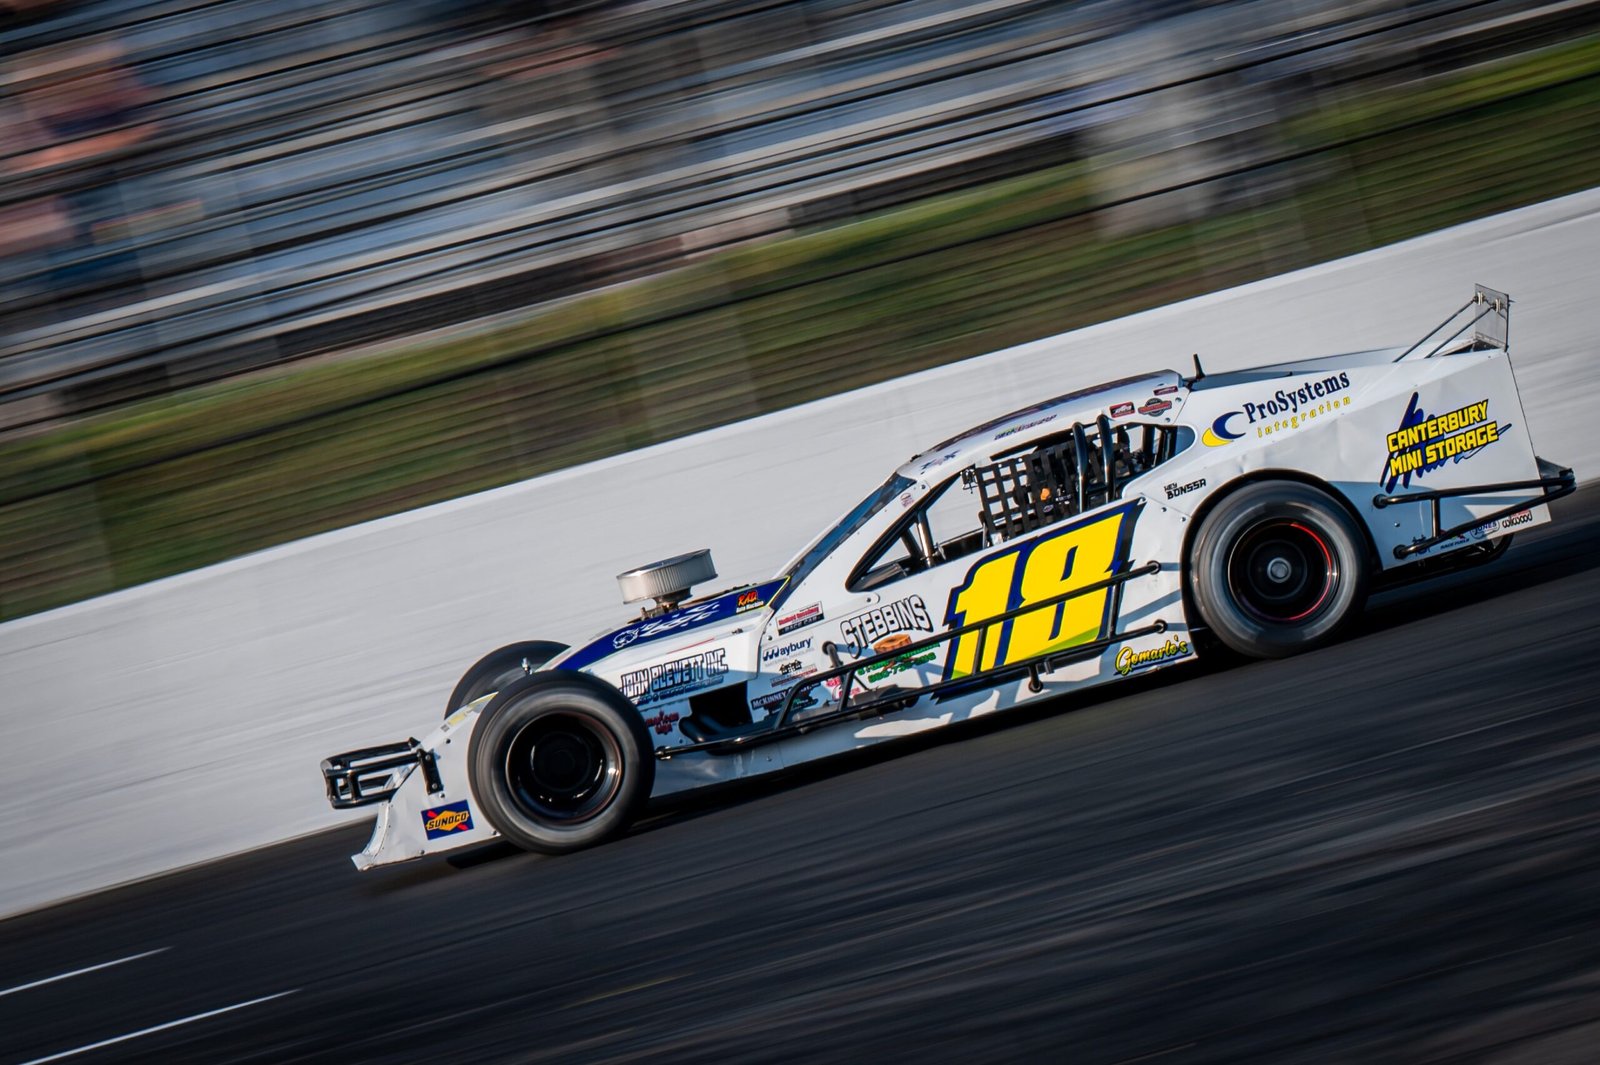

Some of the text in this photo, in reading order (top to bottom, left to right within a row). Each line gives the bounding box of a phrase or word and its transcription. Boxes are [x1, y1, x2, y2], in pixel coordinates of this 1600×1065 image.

[1242, 372, 1350, 424] ProSystems
[1387, 399, 1489, 453] CANTERBURY
[1389, 421, 1499, 477] MINI STORAGE
[948, 508, 1130, 683] 18
[841, 594, 934, 660] STEBBINS
[650, 653, 704, 692] BLEWETT
[428, 811, 470, 830] SUNOCO
